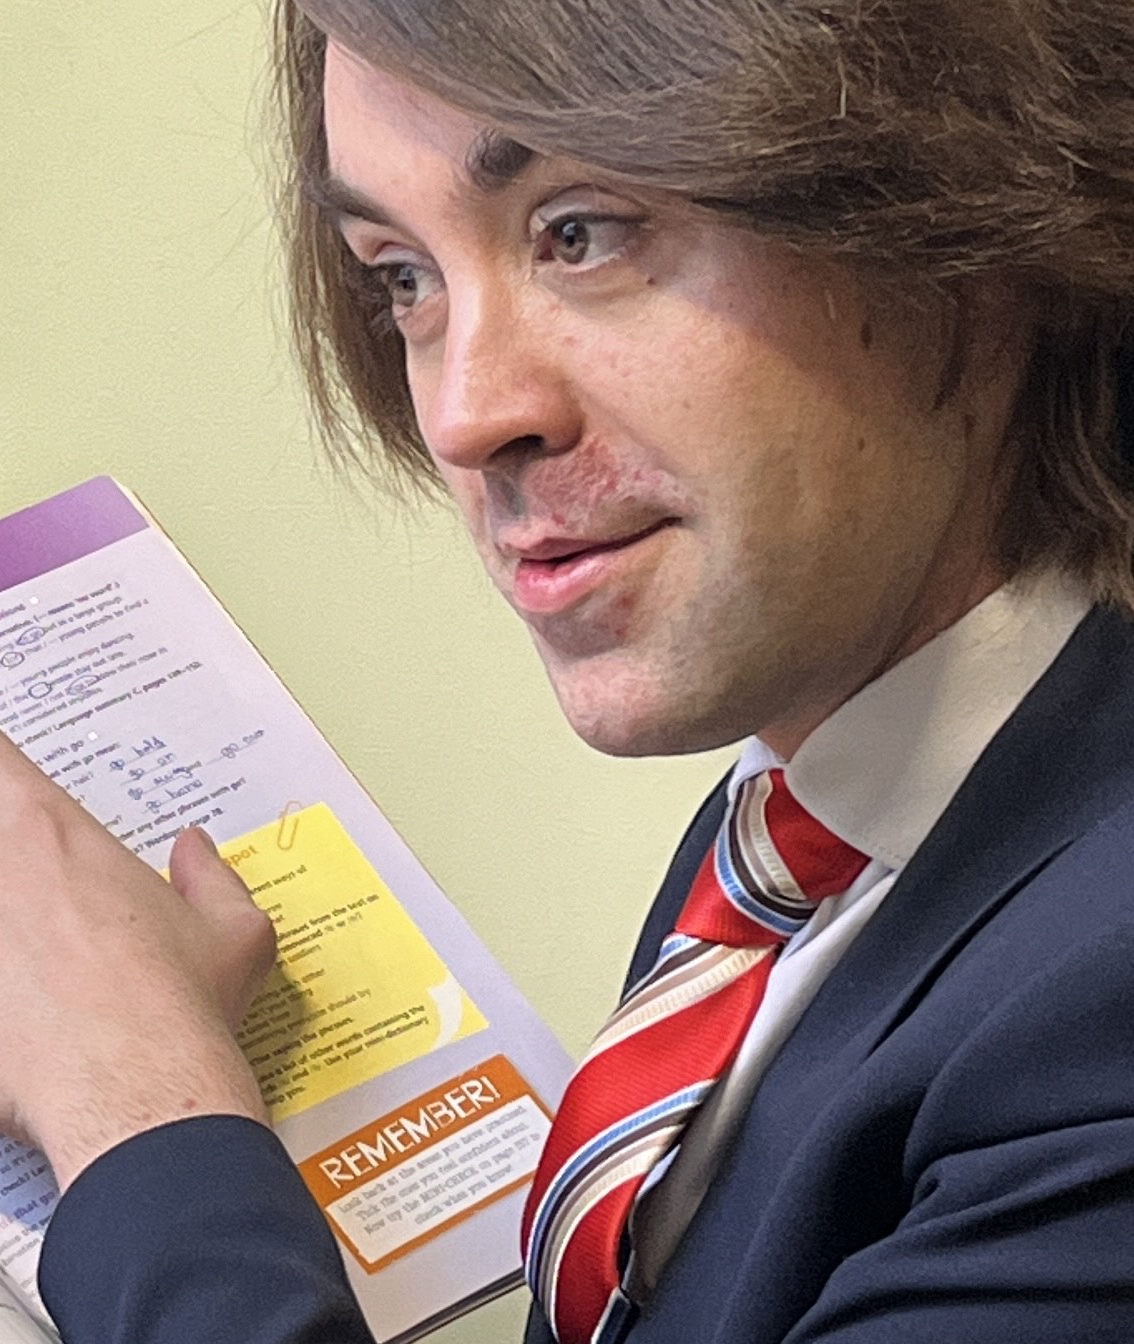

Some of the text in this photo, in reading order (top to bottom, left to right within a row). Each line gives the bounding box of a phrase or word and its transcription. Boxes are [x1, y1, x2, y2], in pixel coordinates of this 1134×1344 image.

[43, 739, 85, 762] with go
[319, 1076, 500, 1189] REMEMBER!
[13, 1199, 40, 1220] that
[38, 1190, 57, 1206] go
